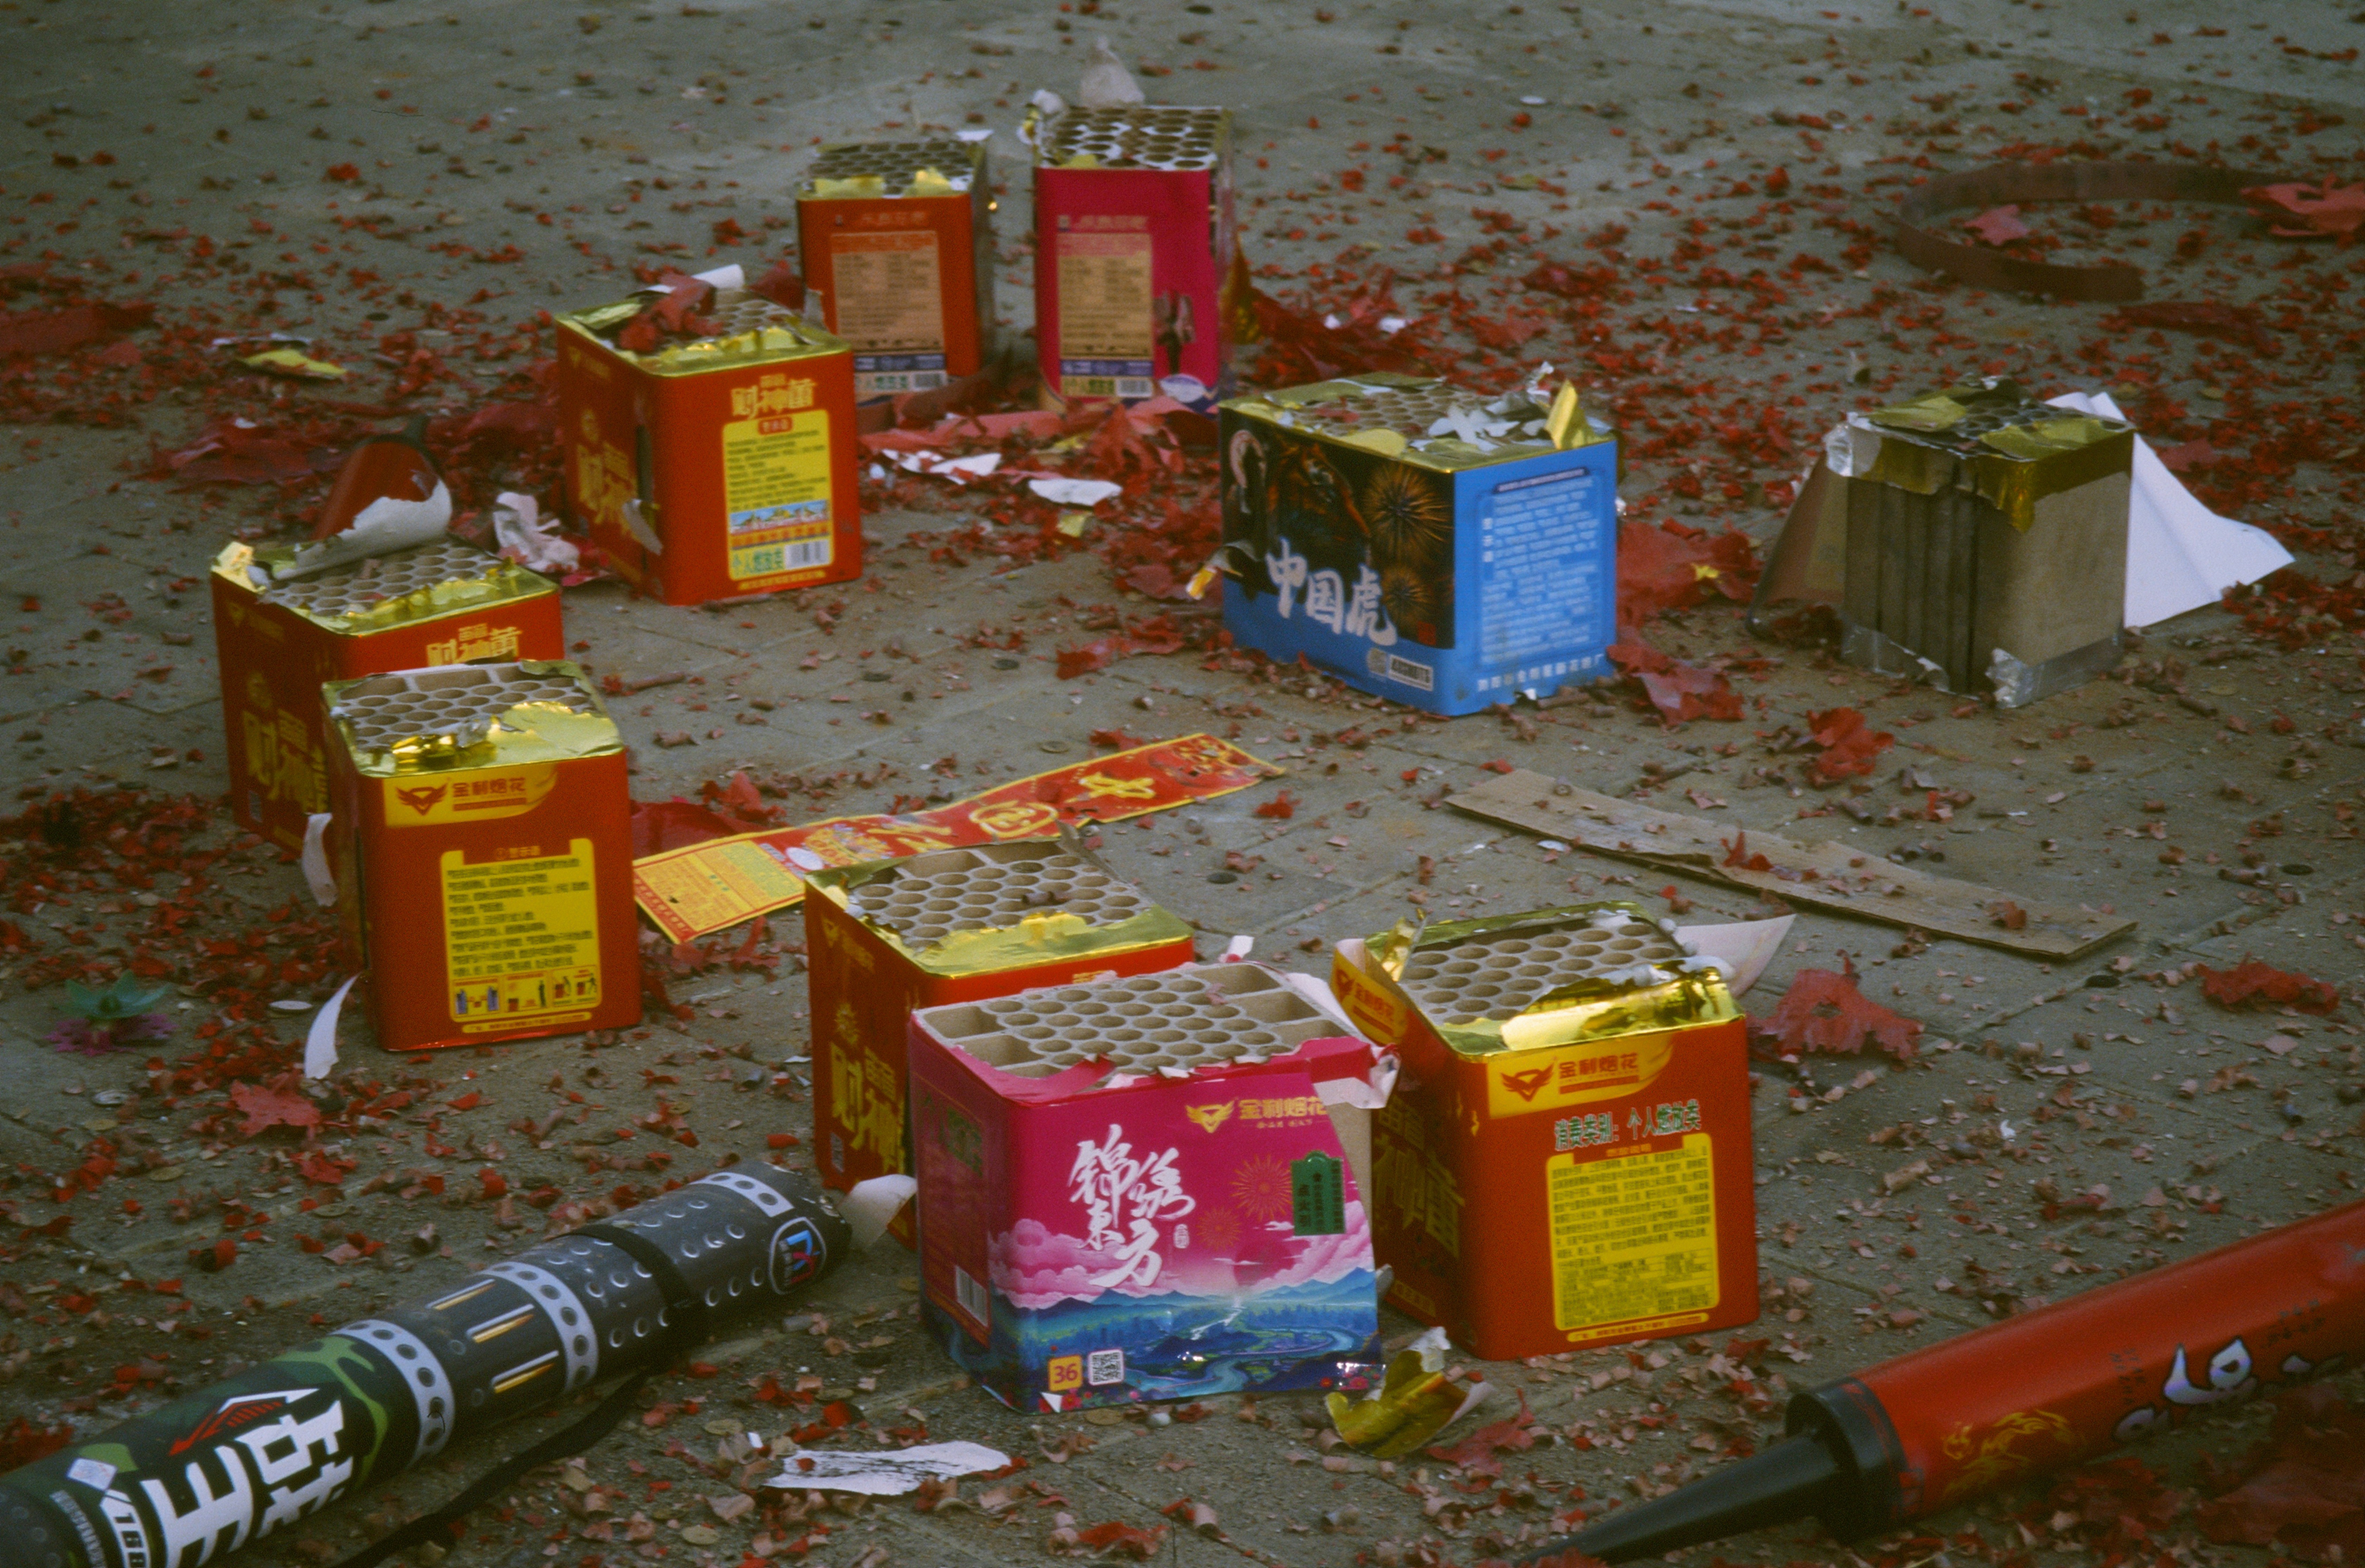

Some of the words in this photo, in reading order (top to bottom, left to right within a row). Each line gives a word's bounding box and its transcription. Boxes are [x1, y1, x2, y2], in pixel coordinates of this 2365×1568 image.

[1265, 536, 1398, 646] 中国虎
[1559, 1052, 1638, 1079] 金利烟花
[1239, 1096, 1328, 1120] 金利烟花
[1055, 1363, 1078, 1384] 36
